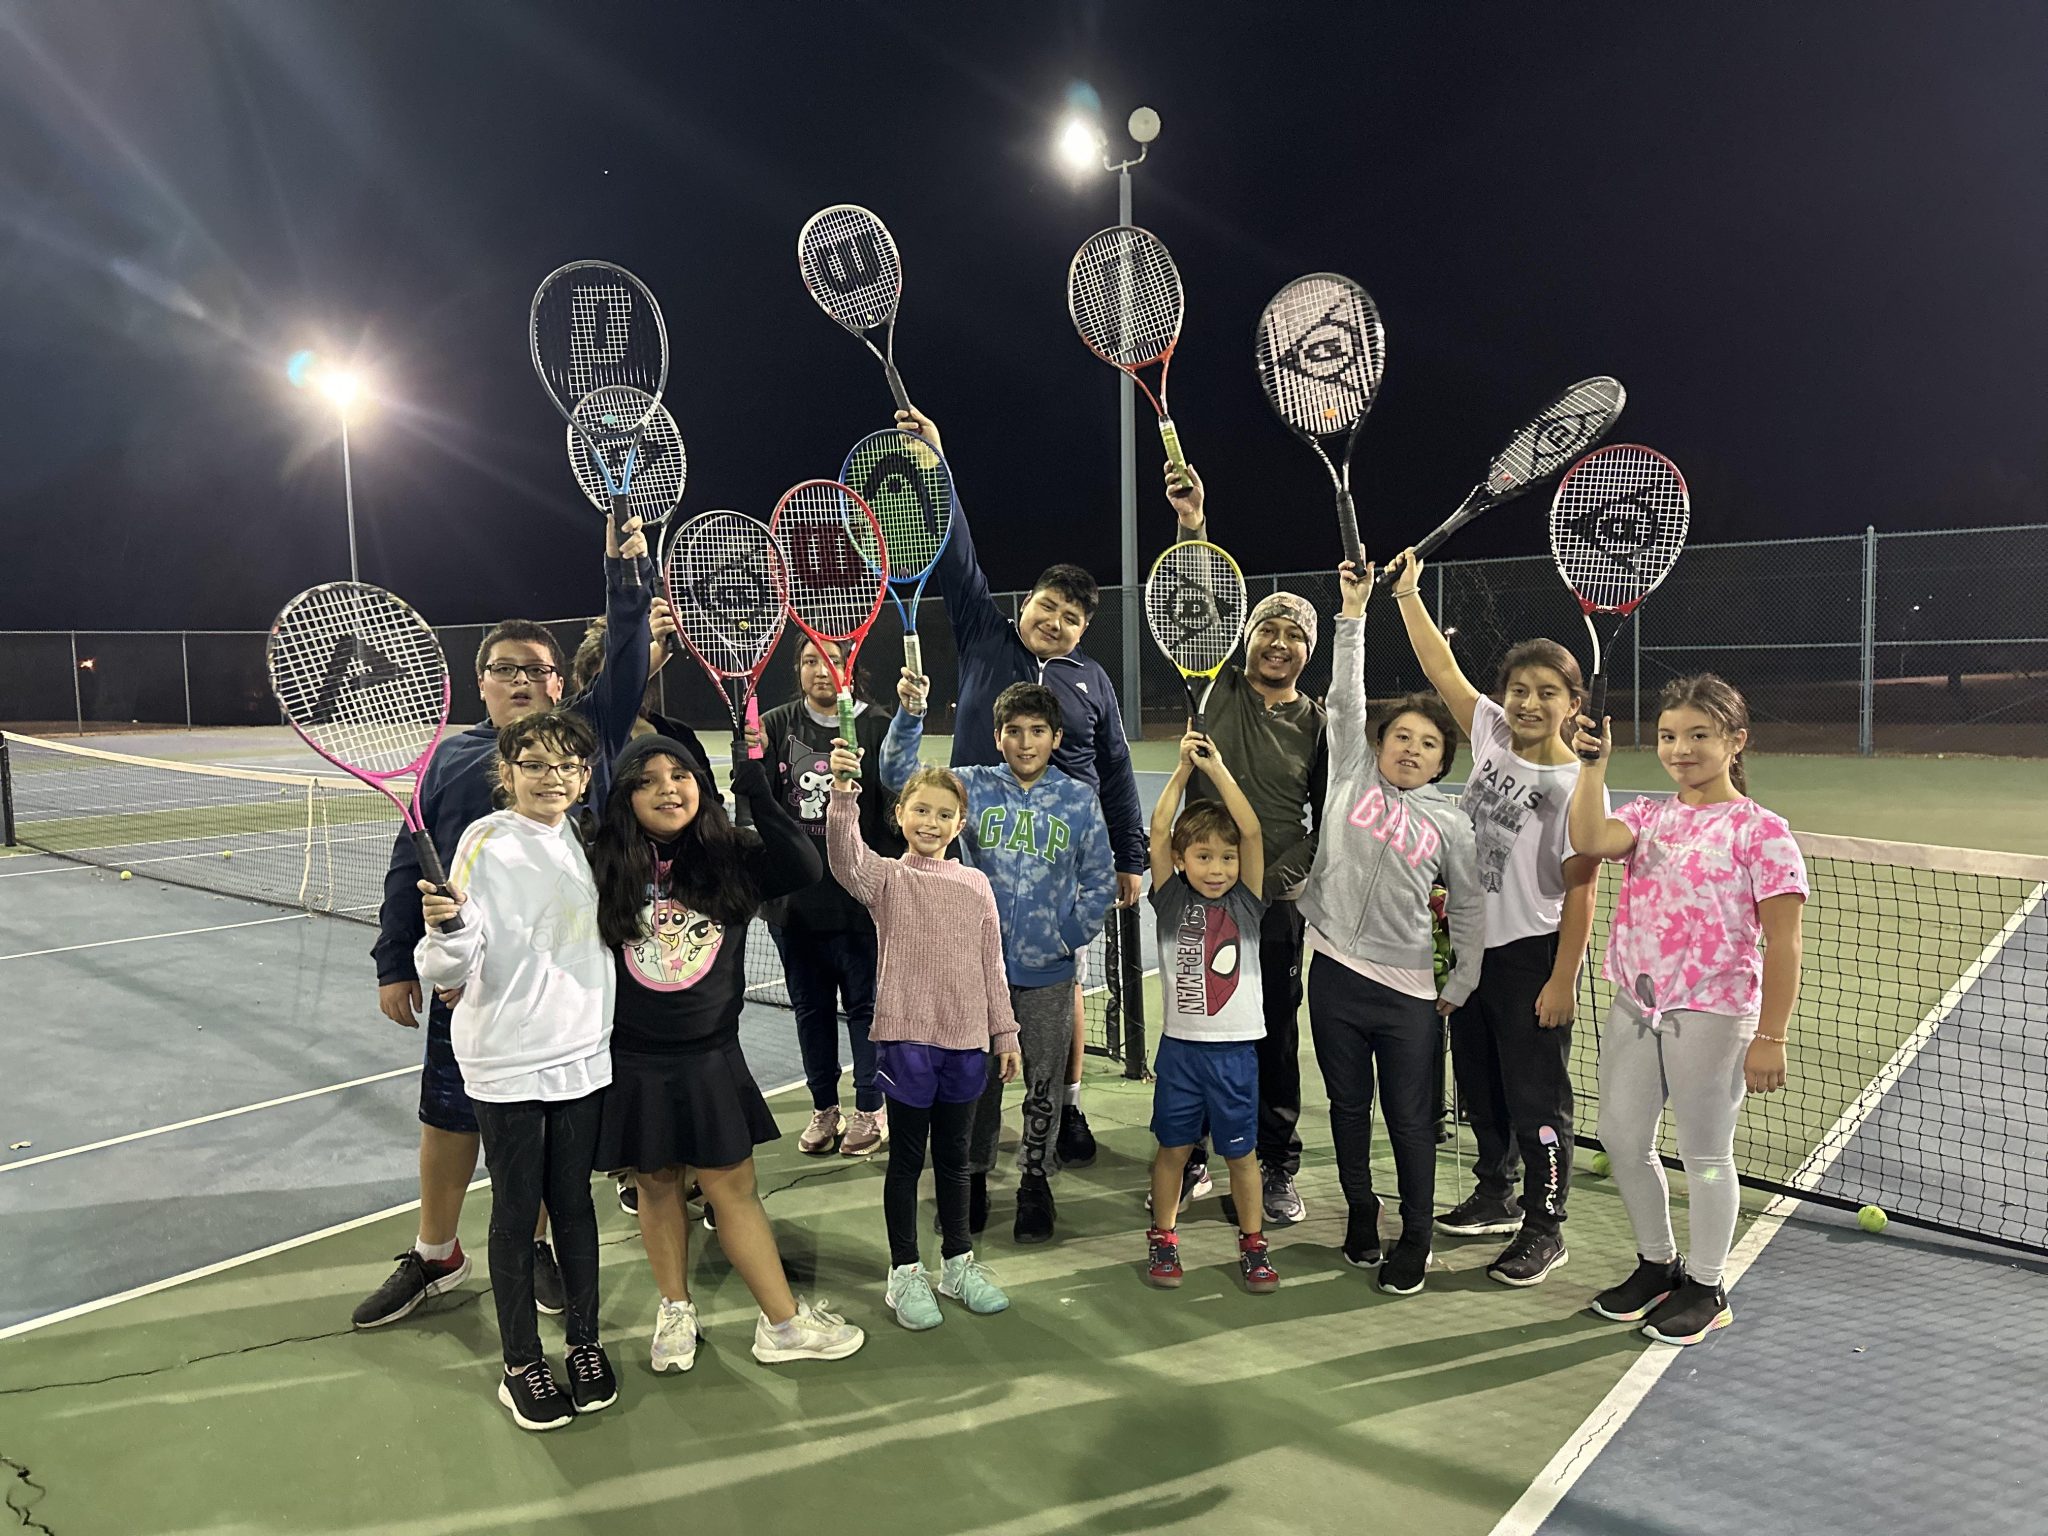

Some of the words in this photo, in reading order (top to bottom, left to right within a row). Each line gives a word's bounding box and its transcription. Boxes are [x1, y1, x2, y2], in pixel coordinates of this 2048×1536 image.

[1482, 758, 1543, 810] PARIS
[978, 805, 1071, 865] GAP
[1348, 785, 1441, 870] GAP
[1176, 904, 1207, 1015] SPIDER-MAN
